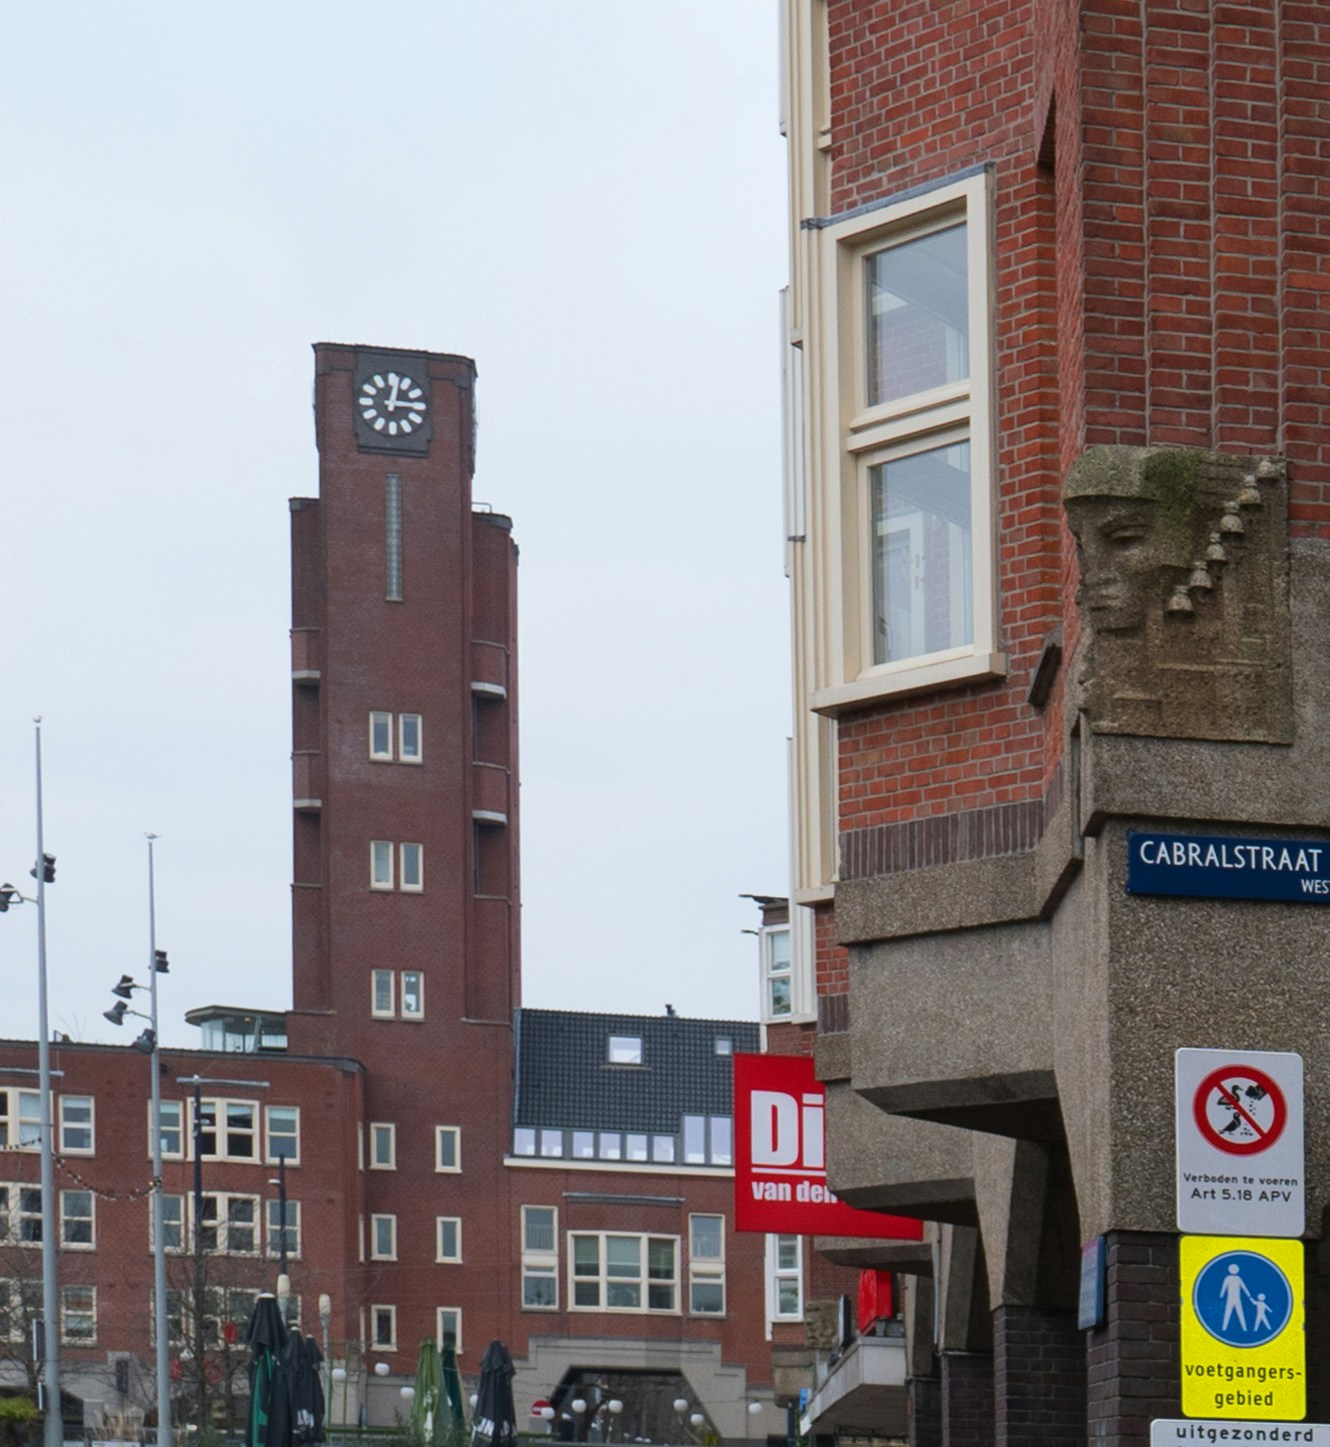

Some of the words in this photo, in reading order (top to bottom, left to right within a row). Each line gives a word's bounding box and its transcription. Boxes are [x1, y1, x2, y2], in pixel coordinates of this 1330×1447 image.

[1140, 841, 1323, 872] CABRALSTRAAT
[750, 1089, 825, 1168] Di
[1184, 1173, 1238, 1184] Verboden
[1243, 1175, 1254, 1185] te
[1259, 1177, 1298, 1186] voeren
[751, 1181, 792, 1201] van
[1191, 1188, 1216, 1200] Art
[1222, 1188, 1252, 1201] 5.18
[1258, 1190, 1292, 1202] APV
[1185, 1363, 1302, 1382] voetgangers-
[1214, 1390, 1273, 1409] gebied
[1176, 1424, 1314, 1443] uitgezonderd
